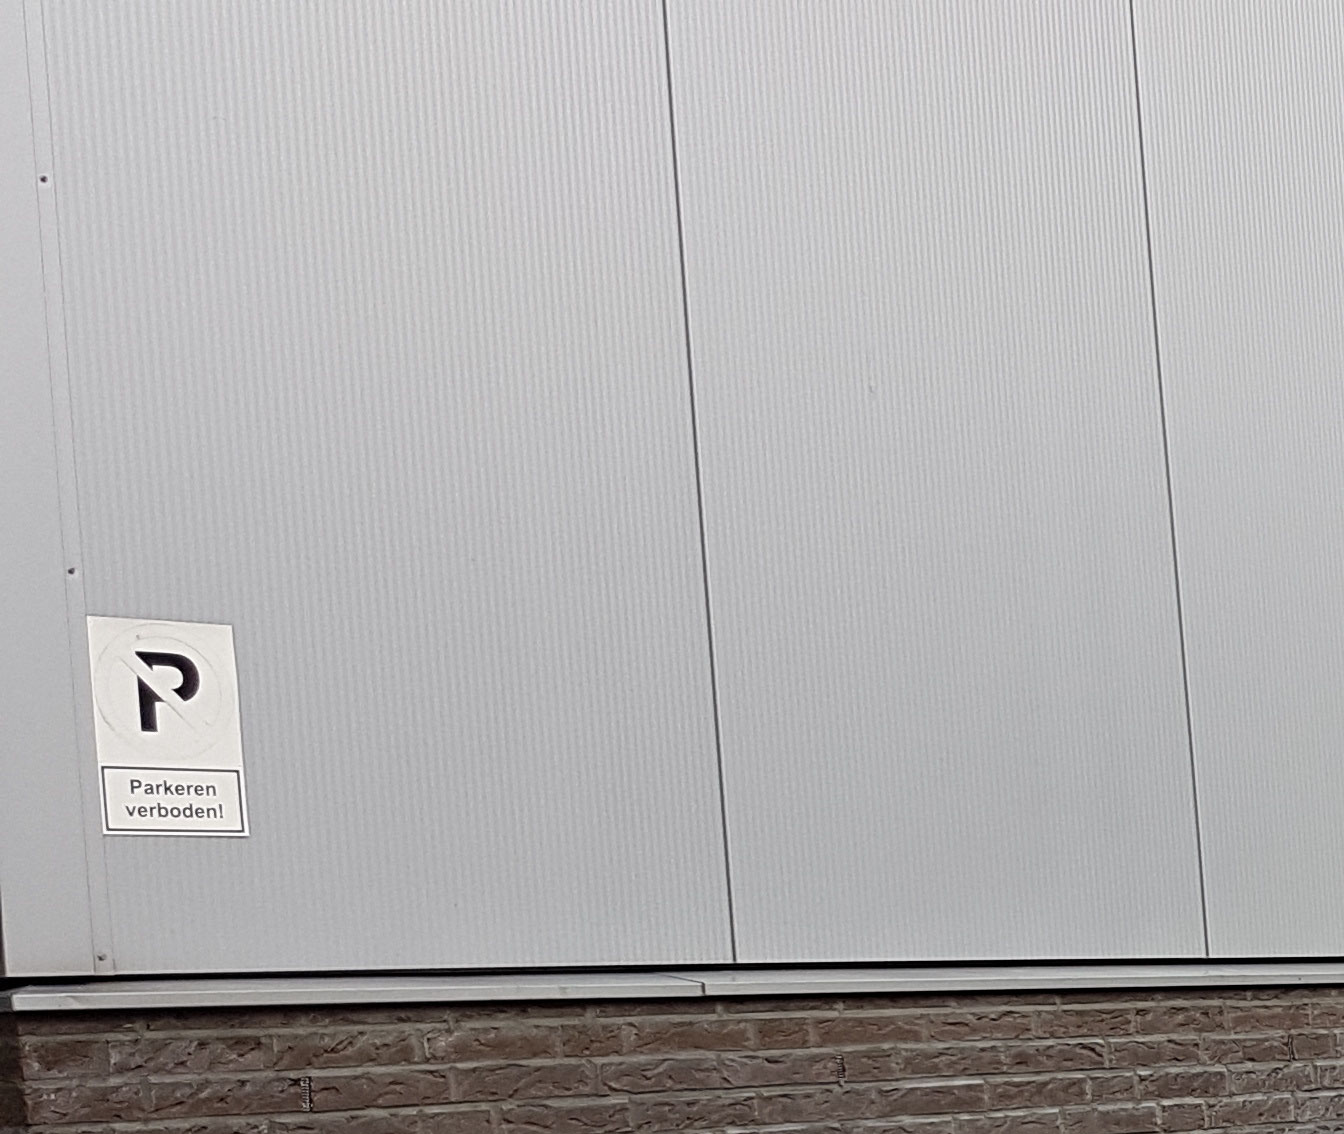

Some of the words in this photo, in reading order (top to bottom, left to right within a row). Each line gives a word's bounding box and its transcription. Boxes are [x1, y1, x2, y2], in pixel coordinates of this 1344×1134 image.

[134, 651, 200, 732] P
[129, 779, 217, 797] Parkeren
[125, 803, 224, 819] verboden!
